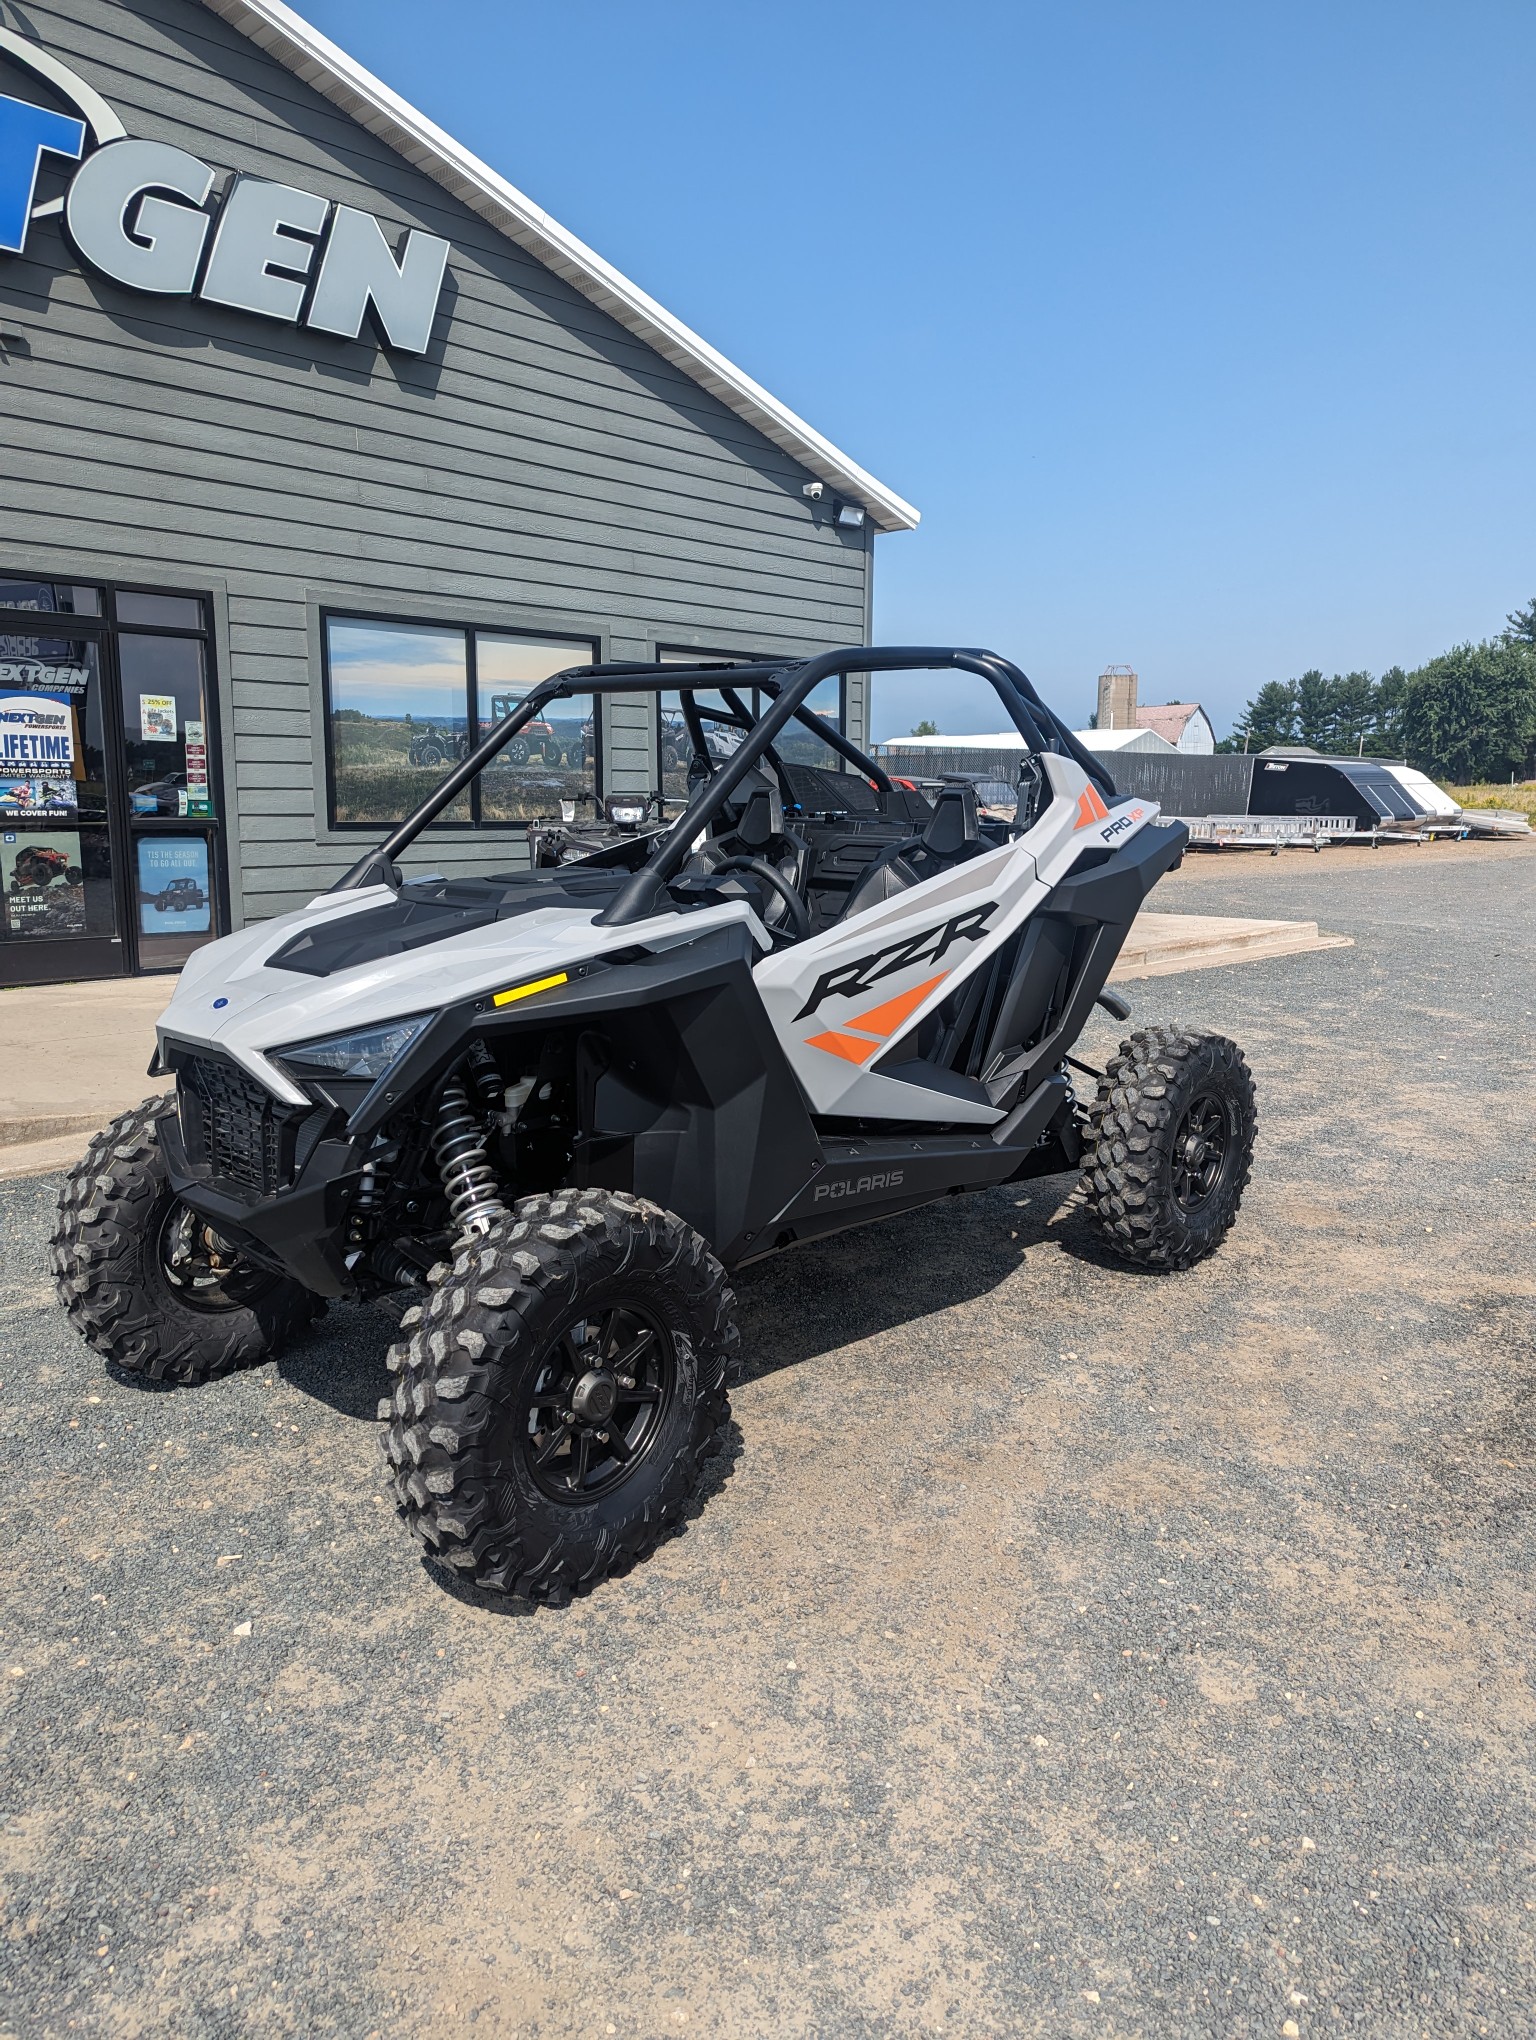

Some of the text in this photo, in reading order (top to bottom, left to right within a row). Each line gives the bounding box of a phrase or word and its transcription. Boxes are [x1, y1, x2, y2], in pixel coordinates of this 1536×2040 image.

[0, 712, 66, 725] NEXTGEN
[0, 734, 71, 760] IFETIME
[9, 896, 31, 904] MEET
[10, 905, 26, 913] OUT
[790, 900, 1000, 1024] RZR
[814, 1170, 904, 1202] POLARIS
